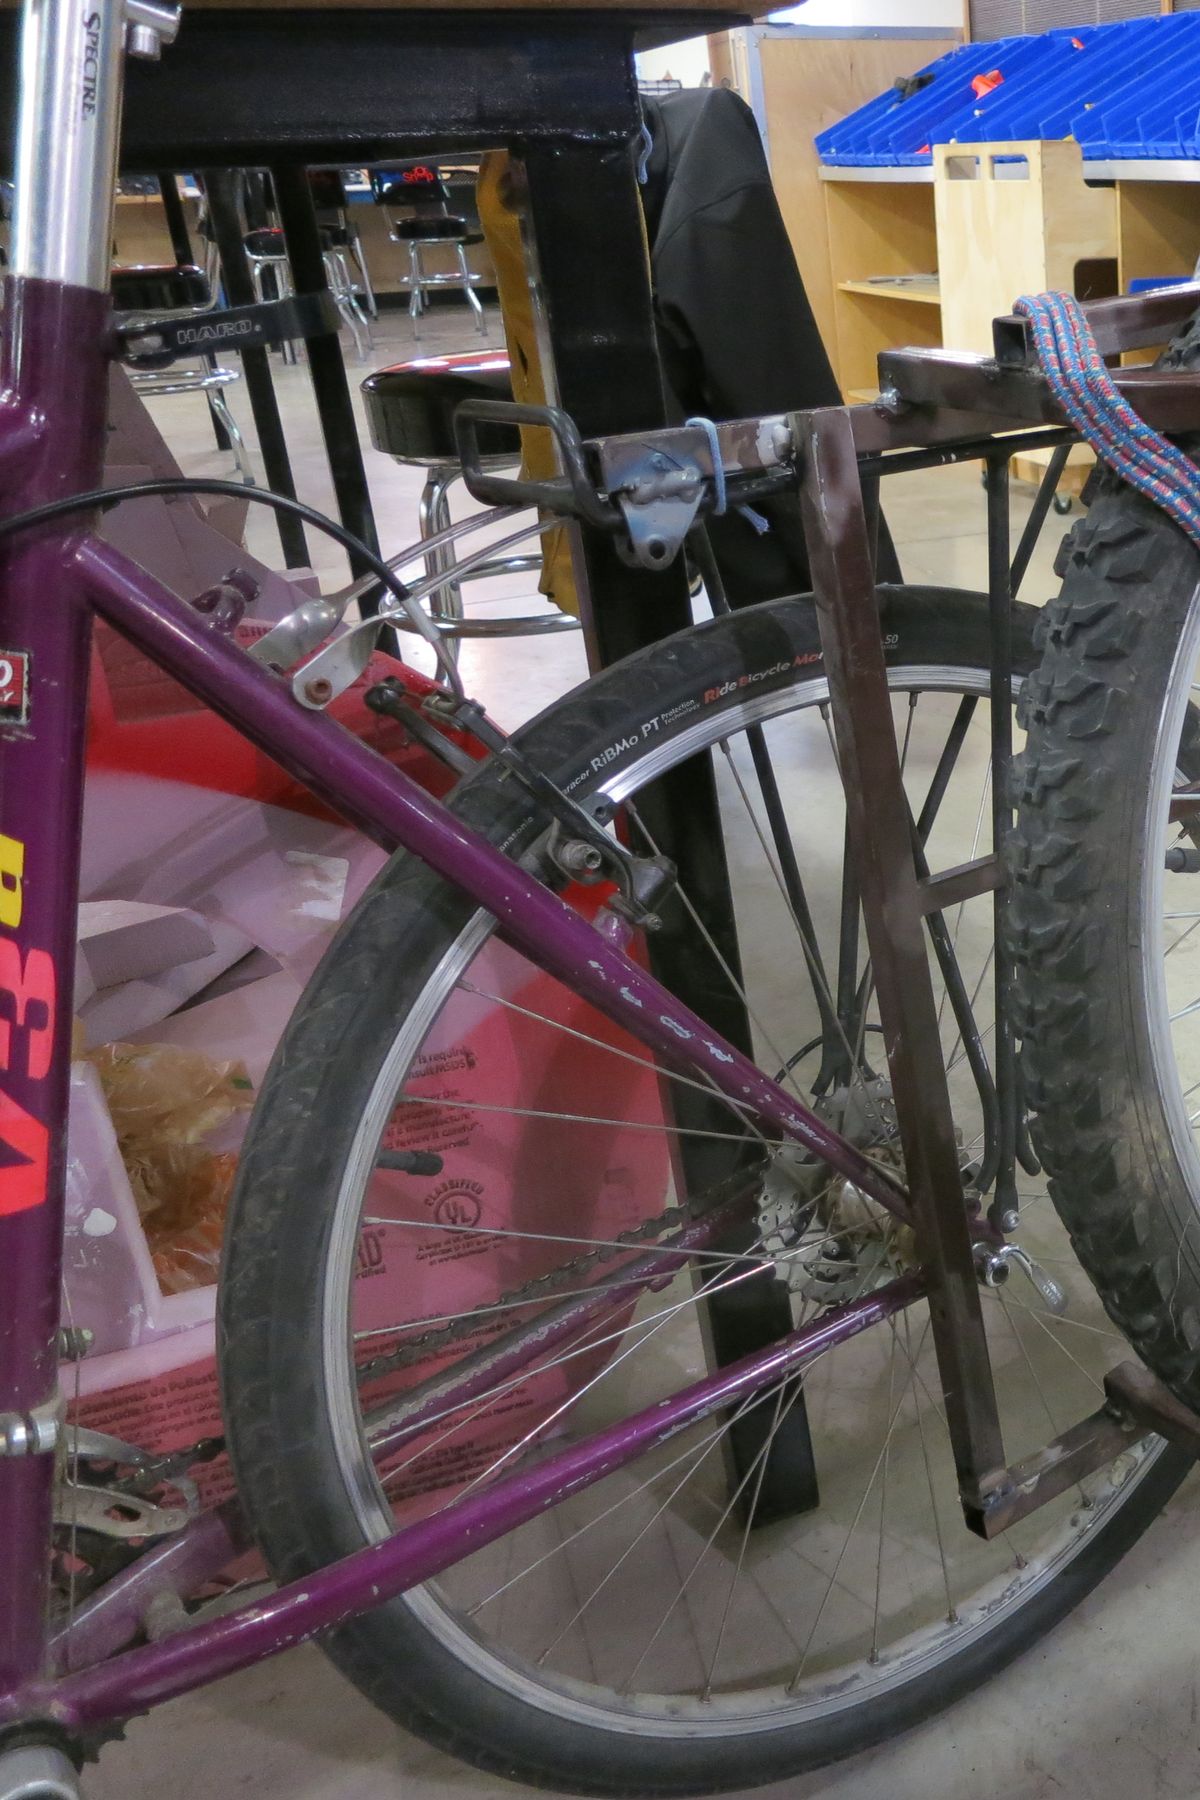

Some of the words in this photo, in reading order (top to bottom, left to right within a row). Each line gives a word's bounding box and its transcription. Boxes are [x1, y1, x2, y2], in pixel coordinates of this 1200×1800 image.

[177, 320, 252, 345] HARO
[641, 707, 661, 739] PT
[498, 816, 535, 853] anasonic
[424, 1178, 485, 1207] CLASSIFIED
